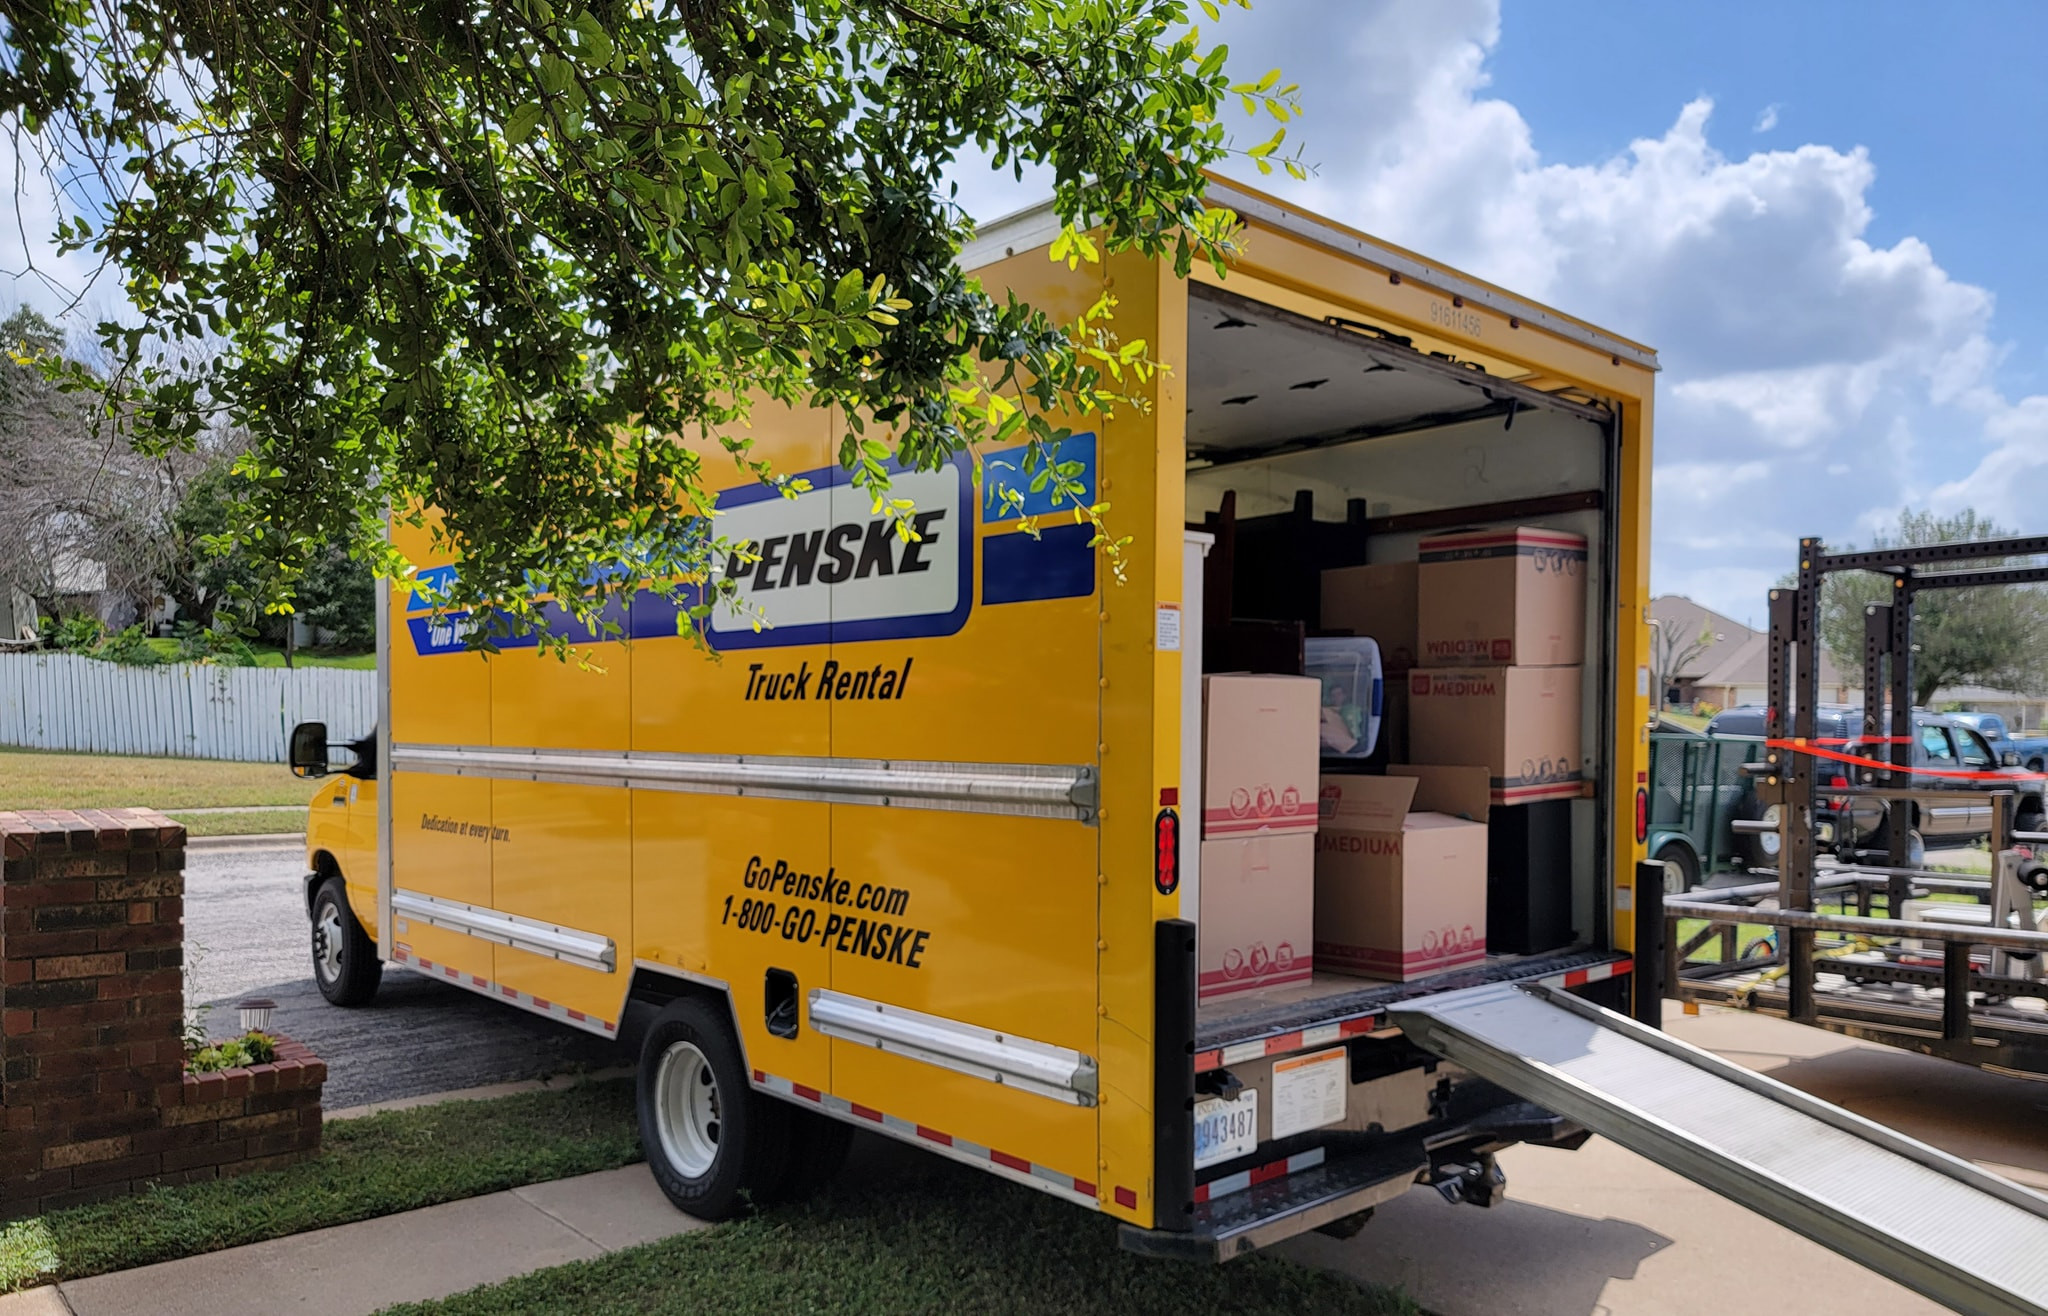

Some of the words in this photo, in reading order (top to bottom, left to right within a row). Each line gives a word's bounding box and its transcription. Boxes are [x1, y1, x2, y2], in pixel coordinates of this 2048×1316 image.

[724, 508, 947, 593] PENSKE
[1426, 640, 1489, 654] MEDIUM
[744, 660, 812, 701] Truck
[815, 656, 914, 701] Rental
[1432, 682, 1497, 696] MEDIUM
[421, 813, 459, 834] Dedication
[459, 821, 469, 836] at
[469, 823, 491, 844] every
[491, 825, 511, 842] turn.
[1323, 835, 1400, 857] MEDIUM
[744, 855, 911, 917] GoPenske.com
[721, 894, 932, 970] 1-800-GO-PENSKE
